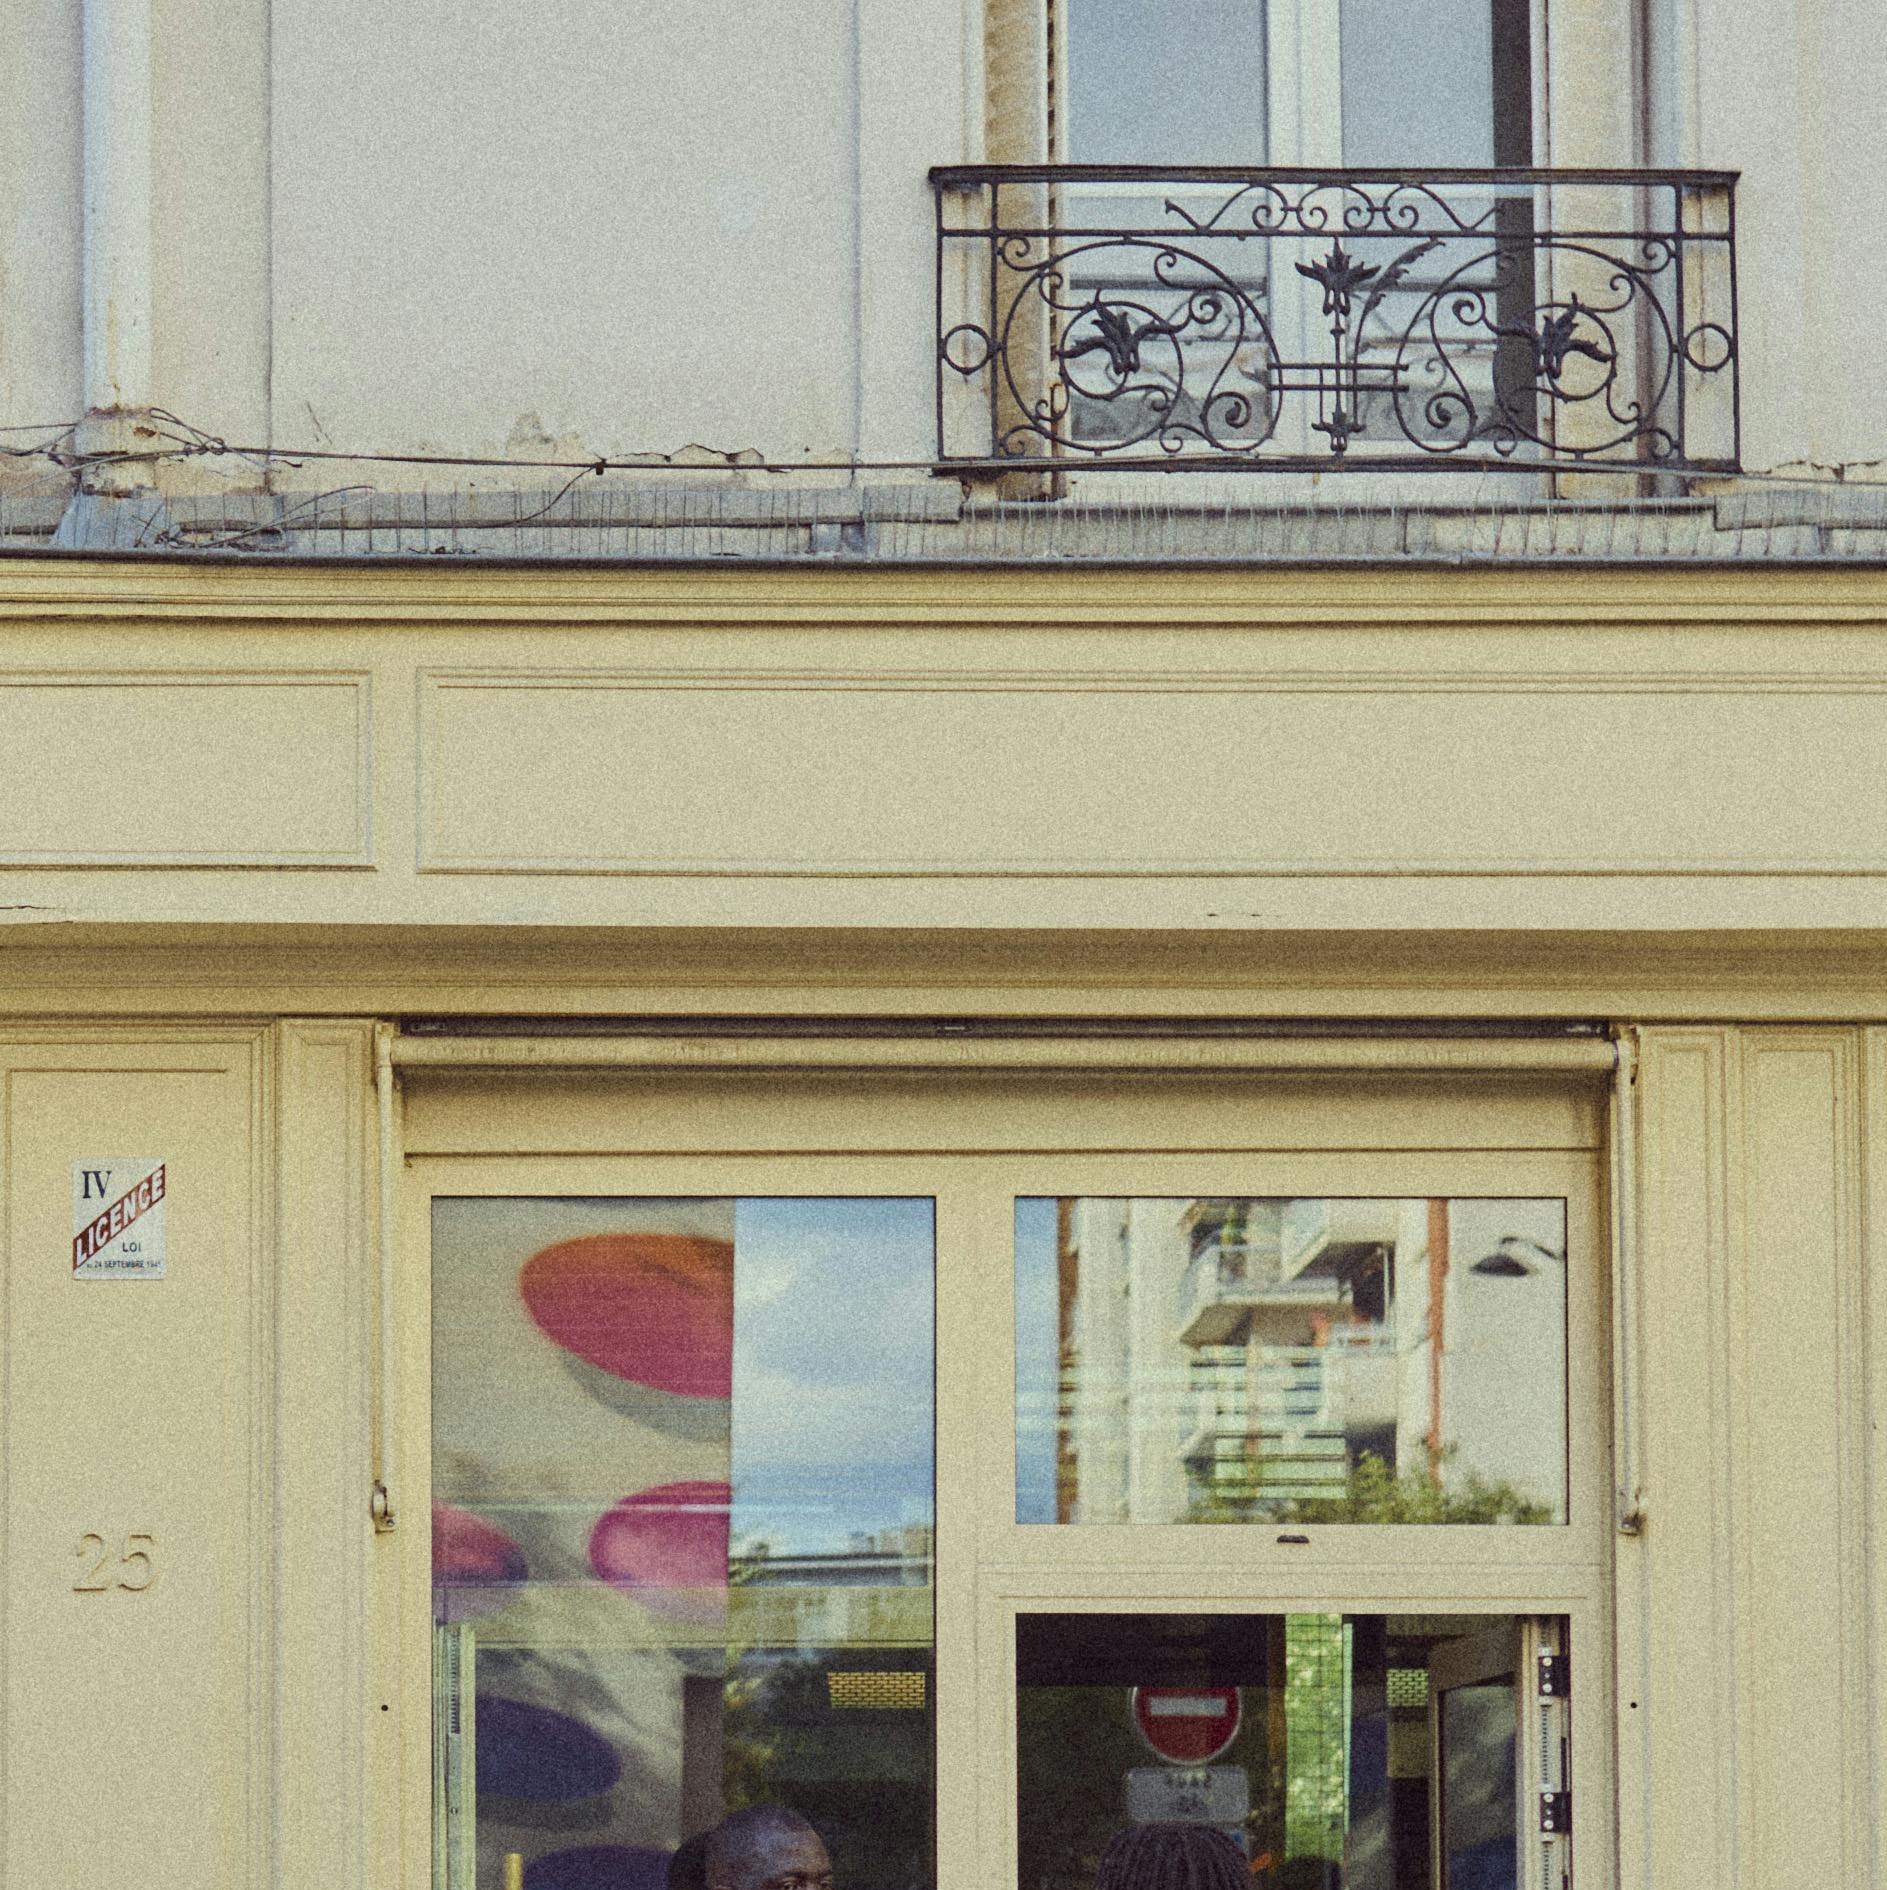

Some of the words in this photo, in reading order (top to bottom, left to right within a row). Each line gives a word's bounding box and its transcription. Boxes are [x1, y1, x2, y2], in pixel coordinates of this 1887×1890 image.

[82, 1170, 112, 1199] IV
[76, 1168, 163, 1266] LICENCE
[122, 1242, 141, 1252] LOI
[104, 1260, 144, 1268] SEPTEMBRE
[72, 1532, 160, 1592] 25
